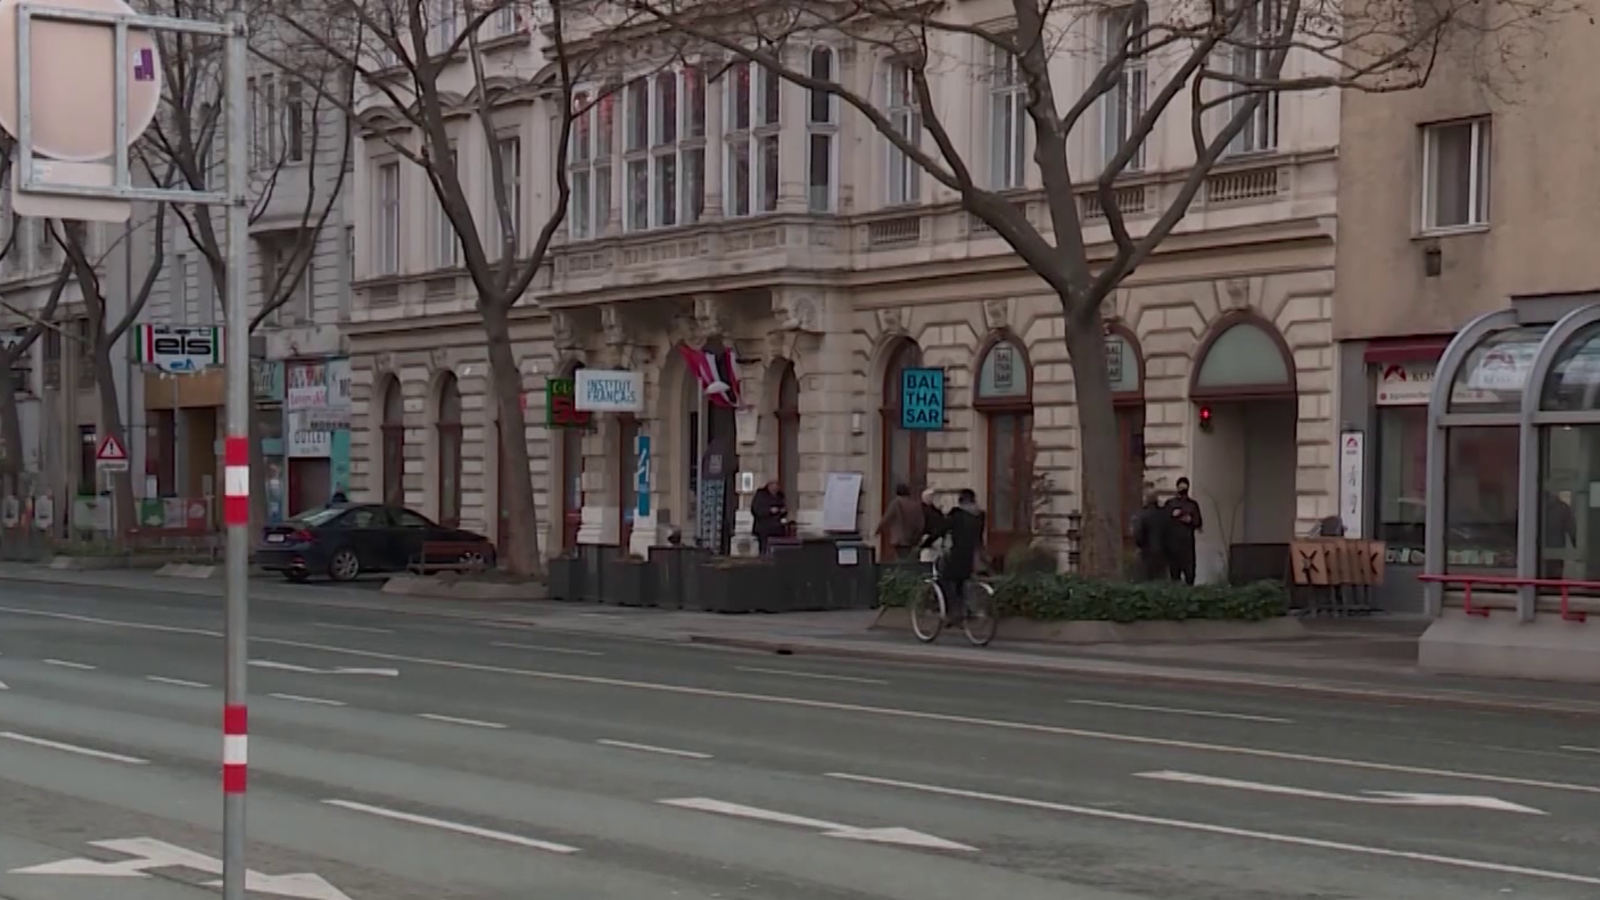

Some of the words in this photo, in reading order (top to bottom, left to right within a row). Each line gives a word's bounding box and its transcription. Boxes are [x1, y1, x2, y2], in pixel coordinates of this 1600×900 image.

[587, 379, 631, 392] INSTITUT
[907, 374, 940, 389] BAL
[905, 391, 941, 406] THA
[905, 408, 940, 424] SAR
[293, 429, 327, 444] OUTLET
